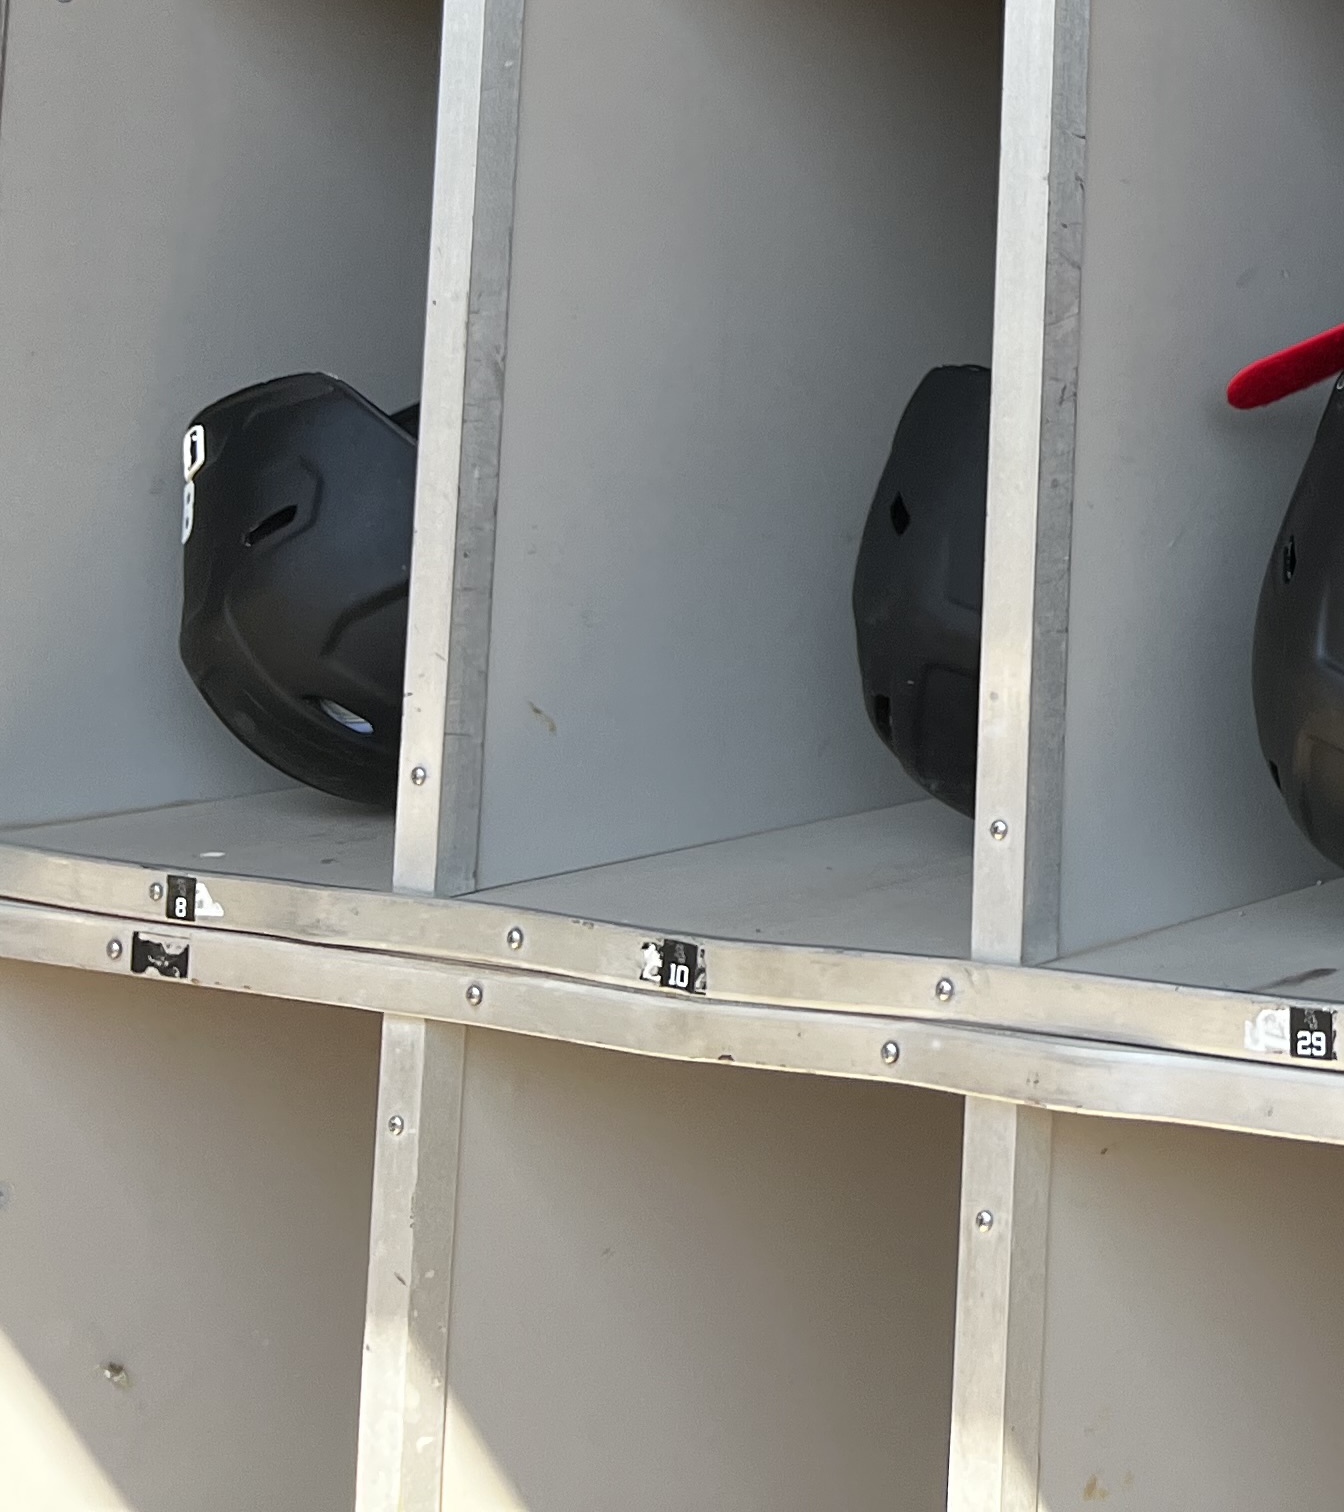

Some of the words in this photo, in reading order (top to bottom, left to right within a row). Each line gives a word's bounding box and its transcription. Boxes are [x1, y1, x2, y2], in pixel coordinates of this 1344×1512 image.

[175, 897, 188, 918] 8
[668, 963, 690, 988] 10
[1297, 1030, 1326, 1057] 29
